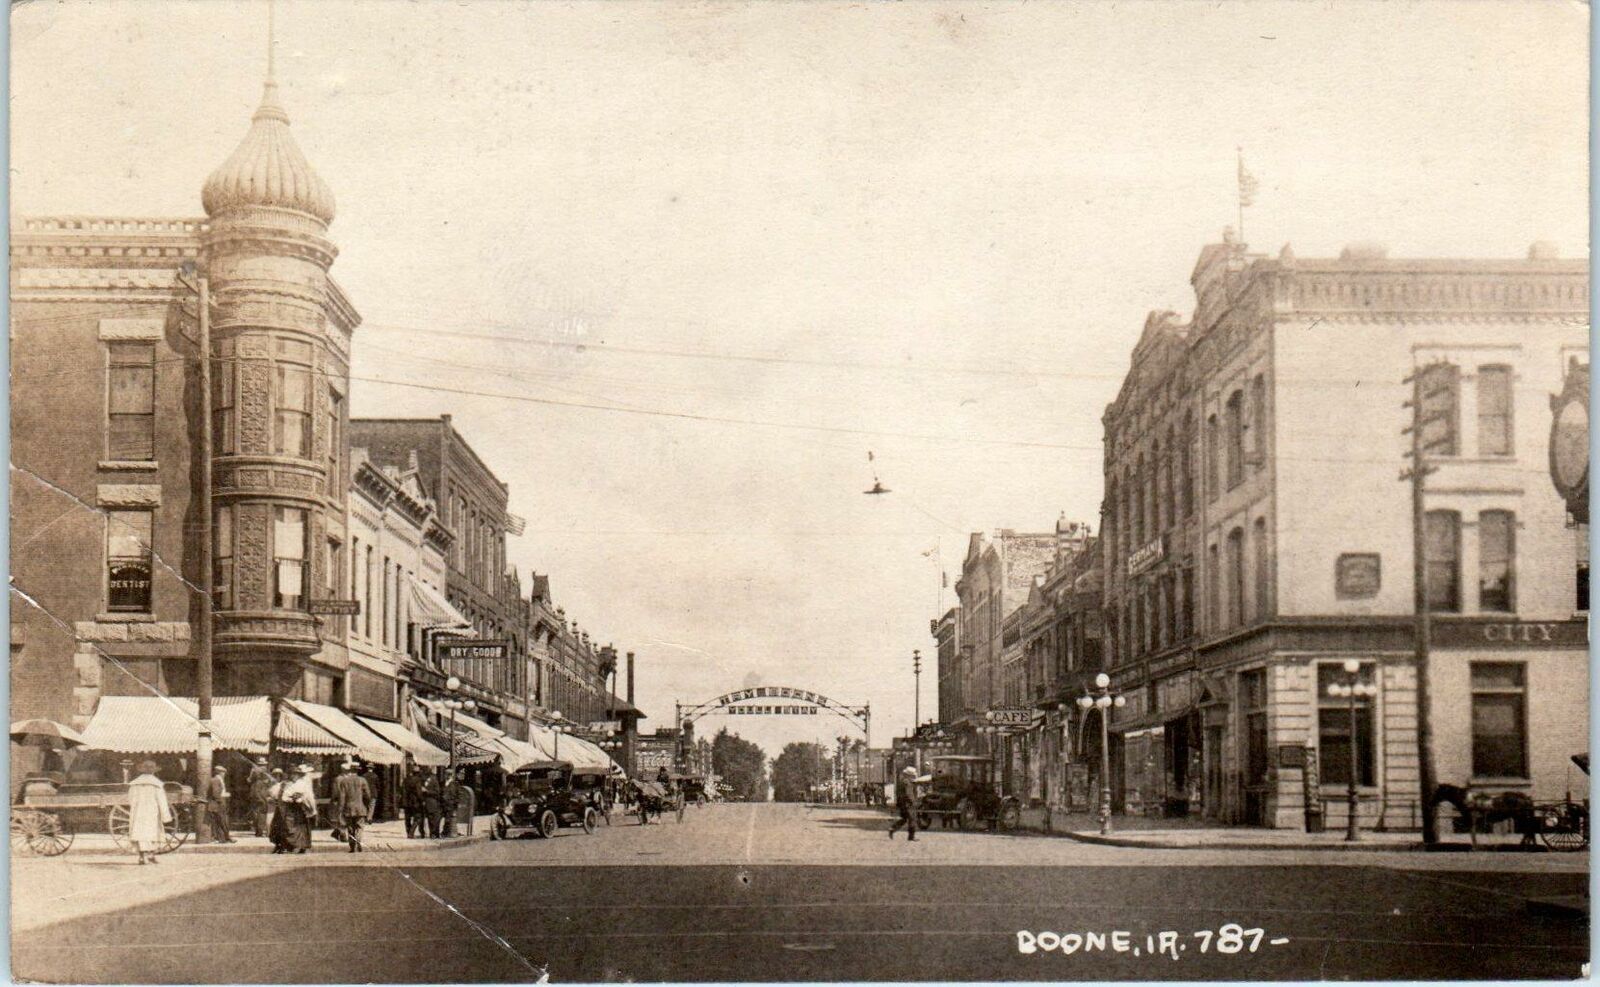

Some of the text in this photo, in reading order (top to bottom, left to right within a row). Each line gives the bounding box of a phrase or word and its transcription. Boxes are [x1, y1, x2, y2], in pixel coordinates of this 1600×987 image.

[110, 580, 150, 589] DENTIST
[1484, 623, 1557, 641] CITY
[450, 647, 503, 658] DRY GOODS
[994, 711, 1029, 723] CAFE
